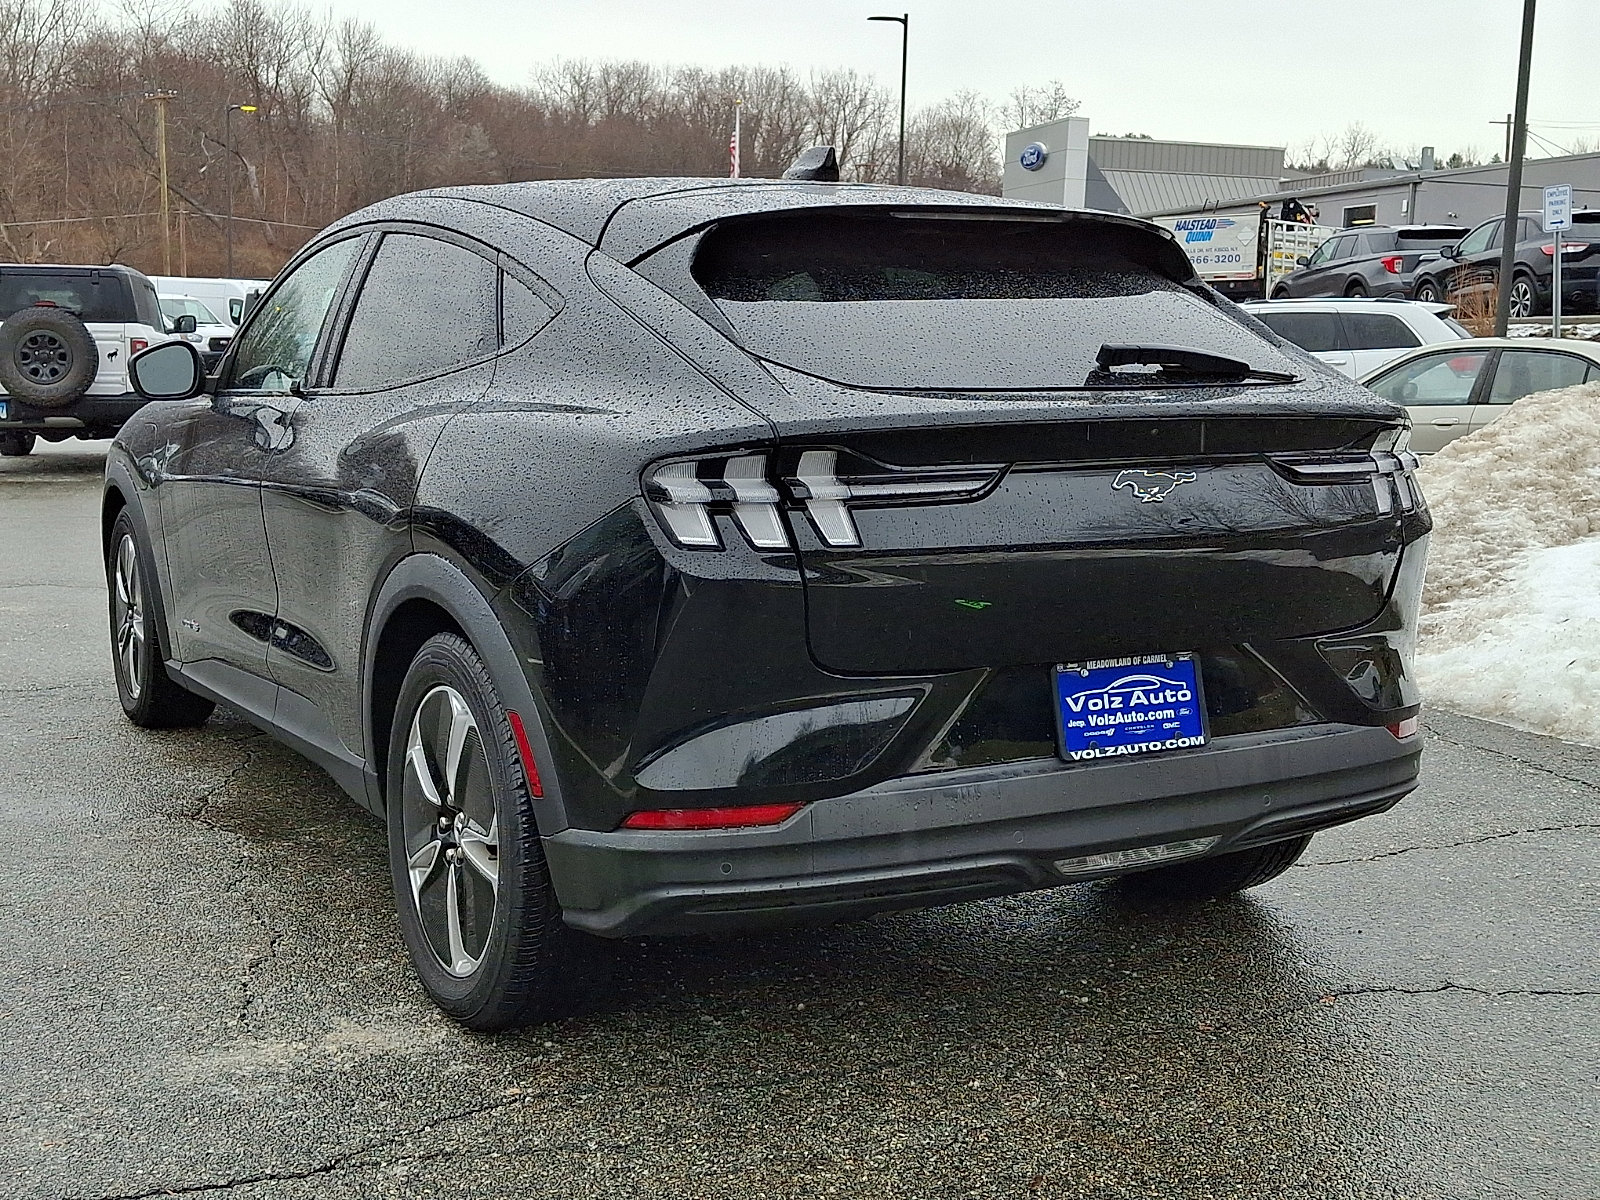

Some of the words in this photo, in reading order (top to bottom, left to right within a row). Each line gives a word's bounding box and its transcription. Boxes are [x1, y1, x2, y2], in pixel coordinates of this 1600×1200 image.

[1174, 218, 1217, 231] HALSTEAD
[1185, 230, 1214, 244] QUINN
[1086, 657, 1132, 670] MEADOWLAND
[1132, 656, 1142, 666] OF
[1142, 653, 1168, 664] CARMEL
[1065, 693, 1124, 713] Volz
[1129, 689, 1192, 707] Auto
[1088, 709, 1175, 727] VolzAuto.com
[1162, 721, 1181, 730] GMC
[1070, 736, 1205, 761] VOLZAUTO.COM
